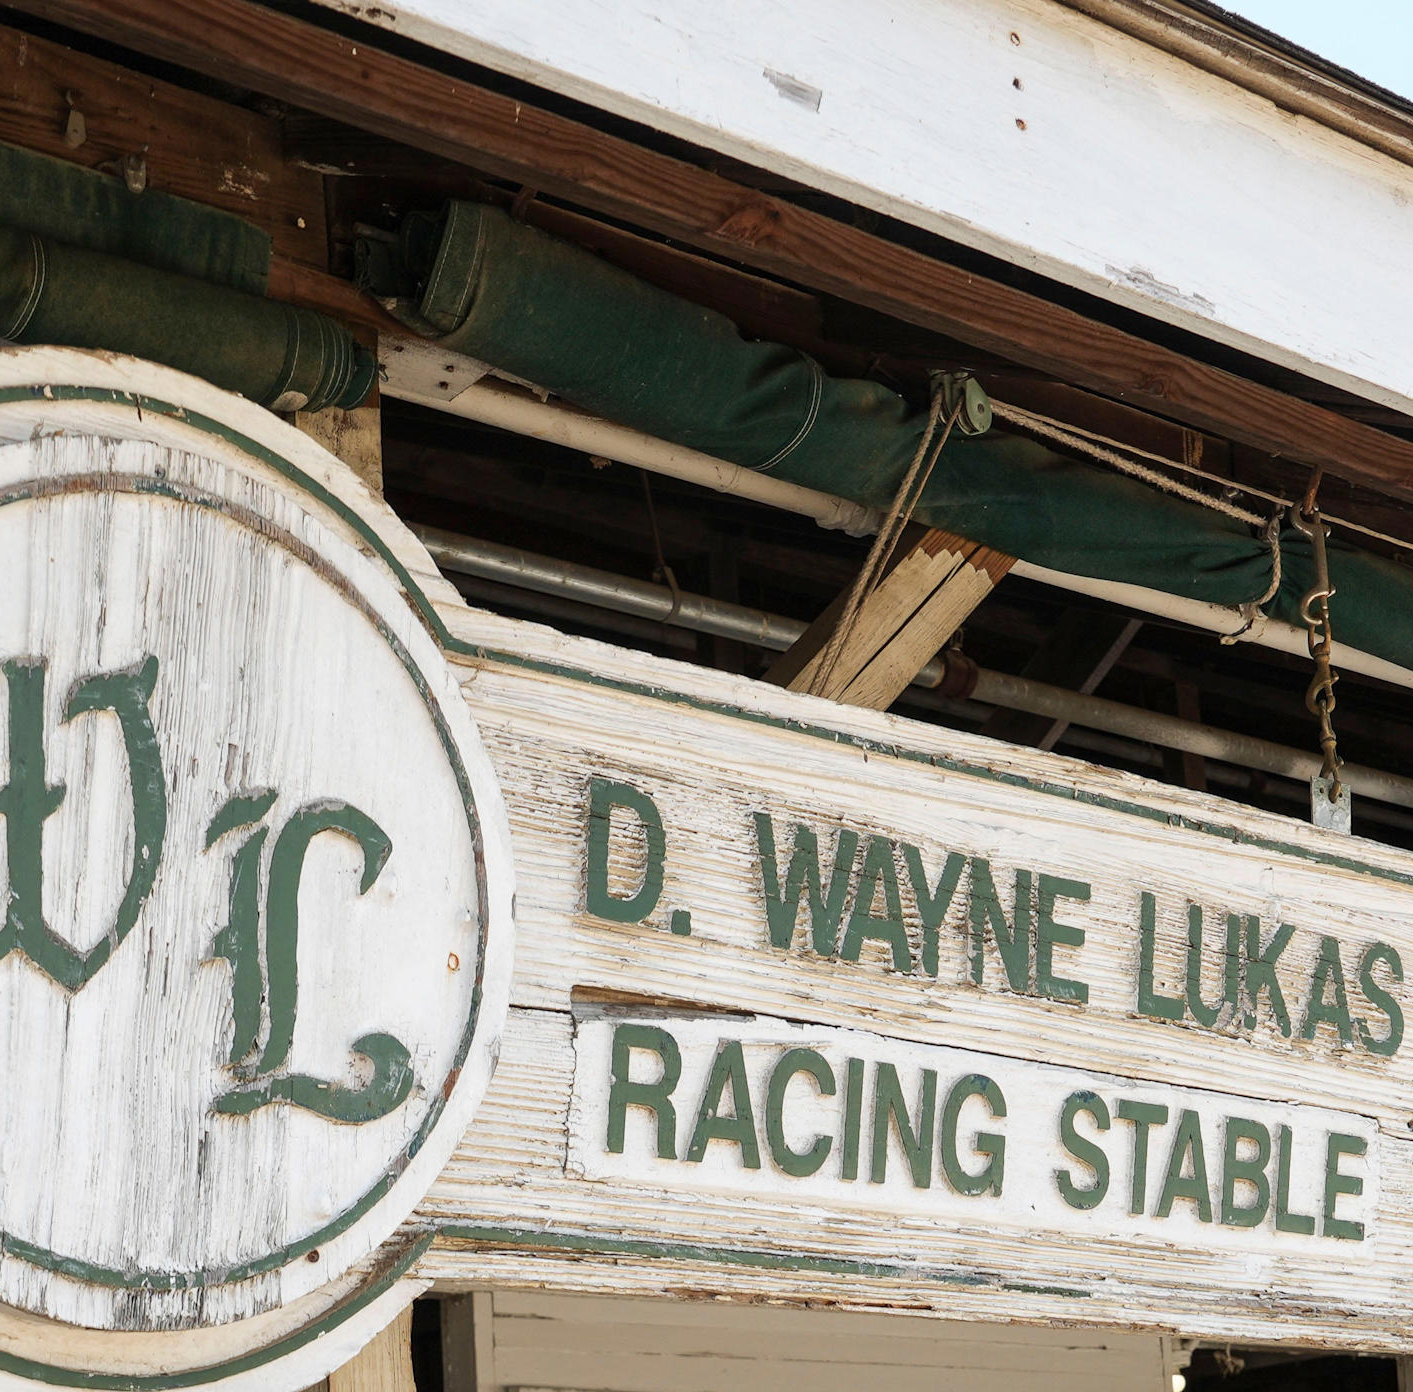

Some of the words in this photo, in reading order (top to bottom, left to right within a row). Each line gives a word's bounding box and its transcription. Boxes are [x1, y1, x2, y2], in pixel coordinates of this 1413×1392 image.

[586, 776, 692, 937] D.
[753, 811, 1093, 1004] WAYNE
[1138, 892, 1405, 1058] LUKAS
[606, 1024, 1008, 1199] RACING
[1055, 1089, 1369, 1242] STABLE
